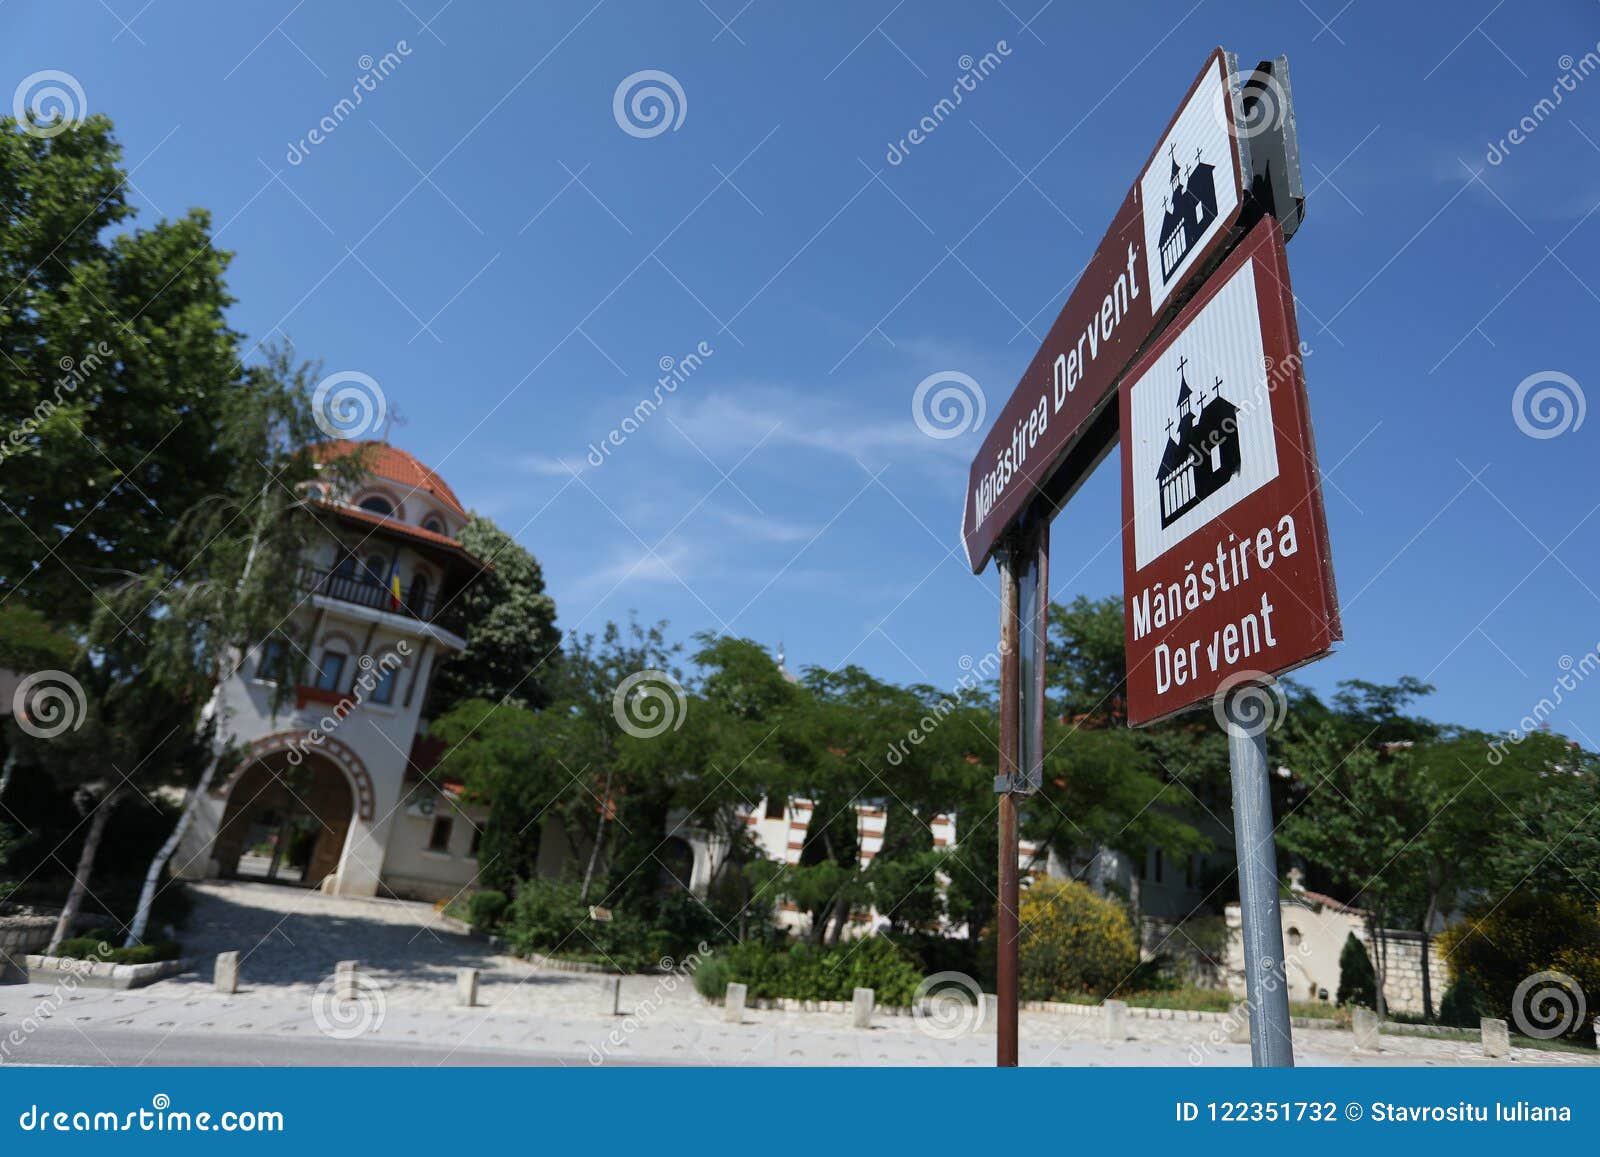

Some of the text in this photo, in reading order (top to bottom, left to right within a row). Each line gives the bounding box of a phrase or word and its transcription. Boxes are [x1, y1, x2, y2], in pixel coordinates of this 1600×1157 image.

[1053, 241, 1139, 414] Dervent
[1132, 514, 1298, 641] Mânăstirea
[1154, 592, 1277, 695] Dervent
